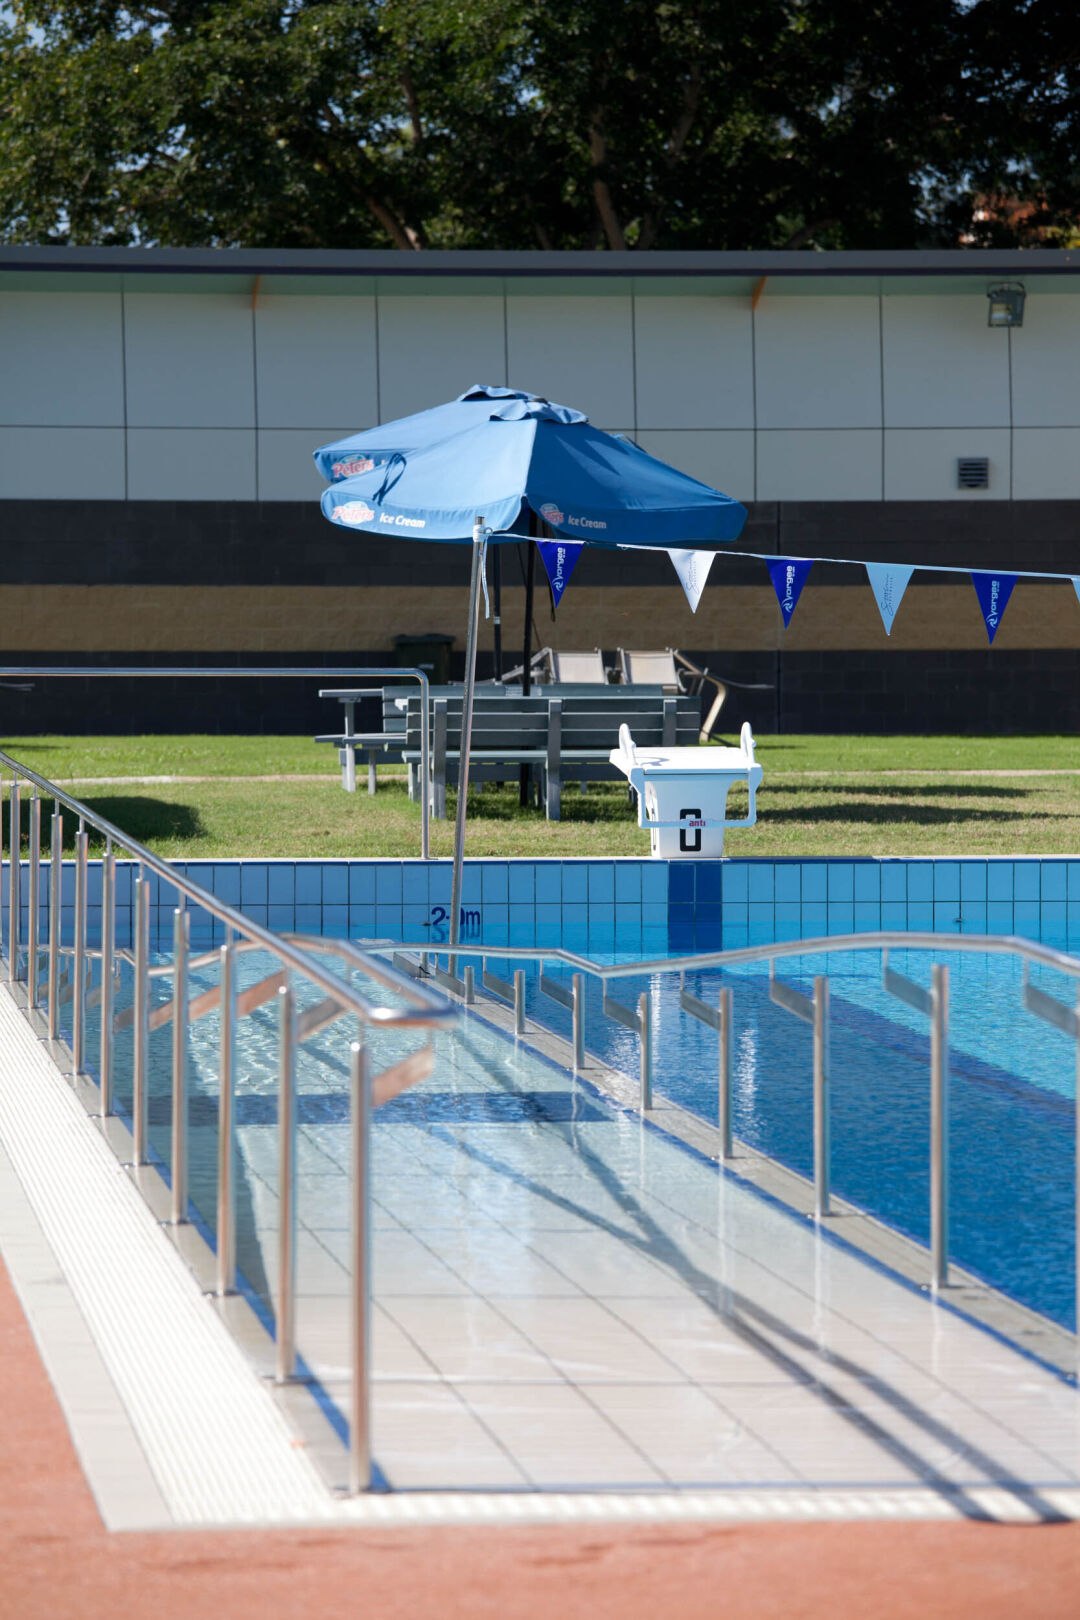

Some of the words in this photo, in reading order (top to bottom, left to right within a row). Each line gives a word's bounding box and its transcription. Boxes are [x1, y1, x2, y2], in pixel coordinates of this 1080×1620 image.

[379, 512, 395, 524] Ice
[395, 515, 426, 528] Cream
[568, 514, 580, 526] Ice
[580, 517, 607, 529] Cream
